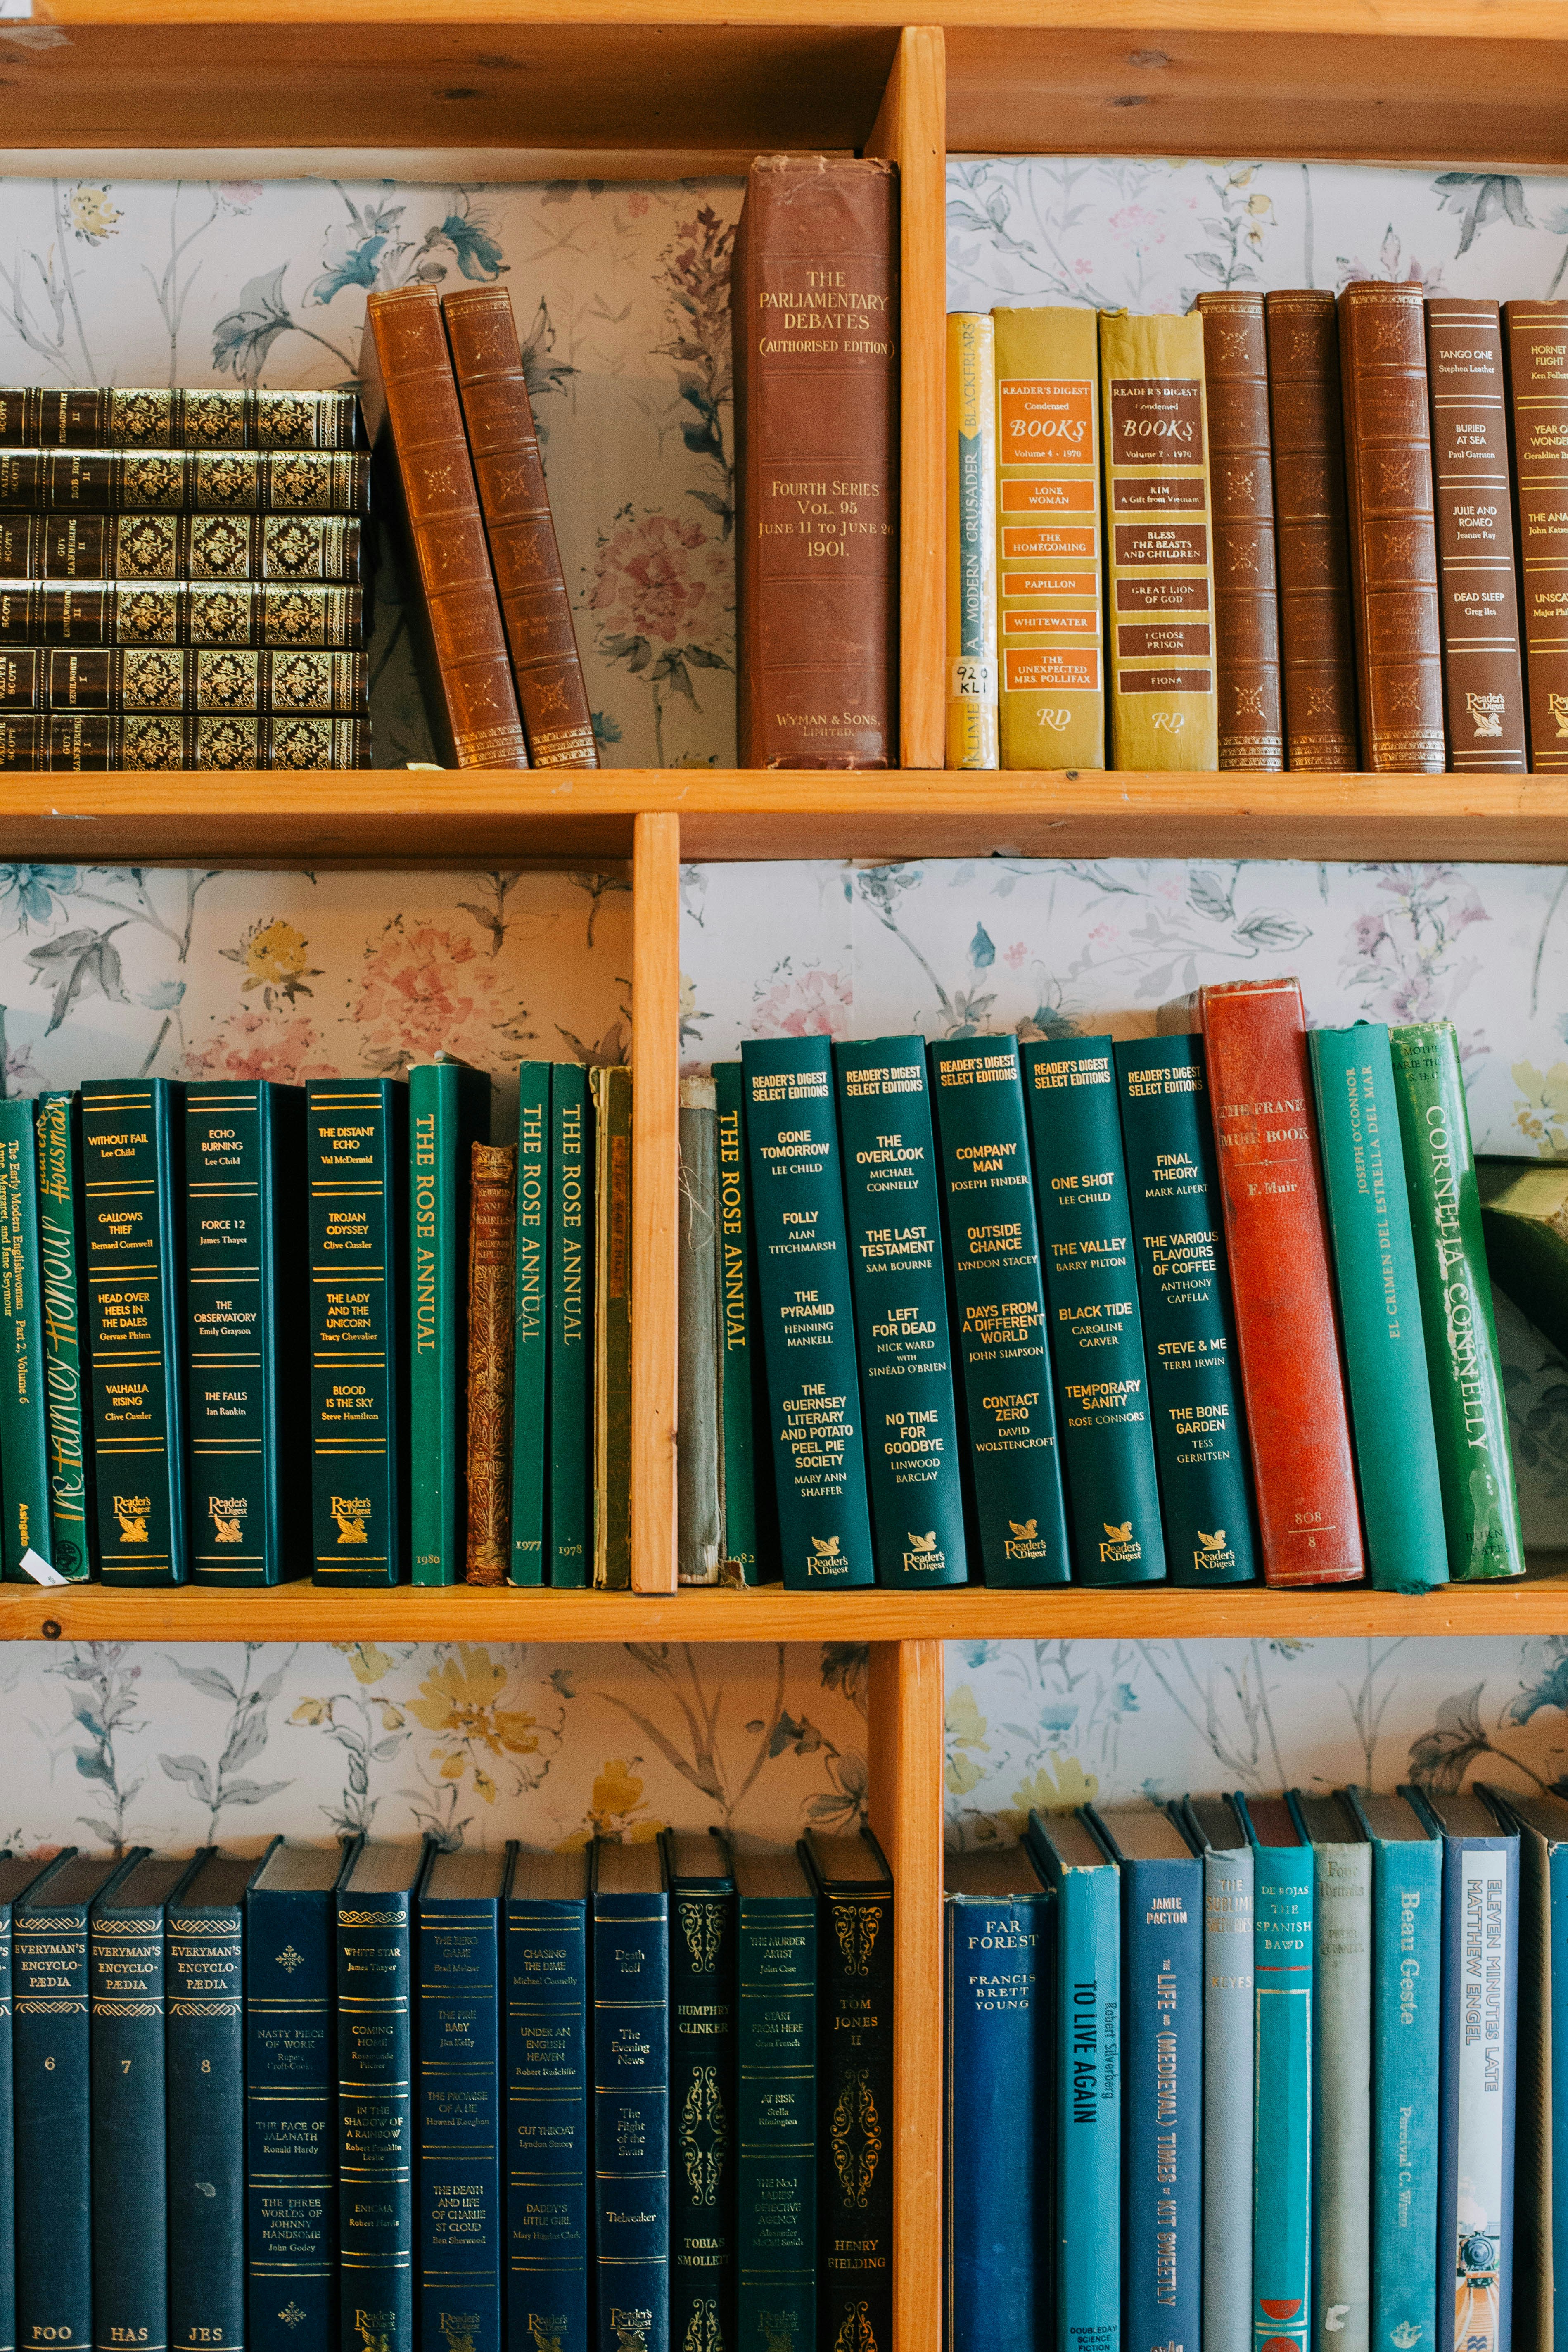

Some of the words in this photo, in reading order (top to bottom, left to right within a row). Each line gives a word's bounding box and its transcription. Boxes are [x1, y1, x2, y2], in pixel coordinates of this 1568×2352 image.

[807, 272, 845, 287] THE
[760, 292, 889, 311] PARLIAMENTARY
[785, 314, 869, 329] DEBATES
[760, 338, 839, 356] (AUTHORISED
[844, 340, 894, 359] EDITION)
[1440, 350, 1472, 358] TANGO
[1474, 351, 1492, 359] ONE
[964, 322, 975, 427] BLACKFRIARS
[1439, 365, 1468, 373] Stephen
[1011, 420, 1086, 442] BOOKS
[773, 481, 826, 496] FOURTH
[833, 481, 879, 496] SERIES
[966, 452, 979, 542] CRUSADER
[797, 501, 834, 514] VOL.
[840, 502, 857, 514] 95
[1453, 506, 1474, 515] JULIE
[759, 523, 793, 538] JUNE
[800, 522, 811, 533] 11
[818, 523, 836, 533] TO
[840, 522, 877, 536] JUNE
[1459, 518, 1493, 528] ROMEO
[68, 520, 76, 574] MANNERING
[808, 542, 849, 556] 1901.
[967, 555, 979, 622] MODERN
[1454, 593, 1479, 601] DEAD
[1482, 593, 1504, 601] SLEEP
[64, 590, 72, 638] KENILWORTH
[967, 637, 979, 650] A
[957, 666, 988, 680] 920
[777, 714, 826, 725] WYMAN
[831, 716, 840, 724] &
[844, 713, 880, 725] SONS.
[1037, 709, 1071, 731] RD
[752, 1074, 795, 1088] READER'S
[796, 1071, 827, 1085] DIGEST
[753, 1089, 786, 1102] SELECT
[788, 1085, 828, 1099] EDITIONS
[1346, 1068, 1362, 1142] O'CONNOR
[88, 1135, 126, 1145] WITHOUT
[130, 1134, 148, 1143] FAIL
[417, 1114, 434, 1165] THE
[778, 1130, 811, 1143] GONE
[114, 1148, 135, 1156] Child
[761, 1143, 829, 1158] TOMORROW
[957, 1143, 1017, 1159] COMPANY
[772, 1166, 787, 1175] LEE
[790, 1163, 822, 1173] CHILD
[973, 1159, 1003, 1172] MAN
[1354, 1146, 1370, 1194] JOSEPH
[1052, 1176, 1078, 1189] ONE
[1082, 1173, 1114, 1188] SHOT
[1249, 1184, 1261, 1195] F.
[1265, 1181, 1297, 1193] Muir
[417, 1175, 434, 1237] ROSE
[98, 1212, 143, 1222] GALLOWS
[329, 1213, 365, 1222] TROJAN
[783, 1211, 818, 1224] FOLLY
[109, 1225, 132, 1234] THIEF
[202, 1220, 230, 1229] FORCE
[235, 1220, 245, 1229] 12
[326, 1226, 369, 1235] ODYSSEY
[1426, 1104, 1464, 1269] CORNELIA
[1449, 1282, 1489, 1452] CONNELLY
[216, 1301, 232, 1309] THE
[418, 1247, 434, 1354] ANNUAL
[194, 1313, 256, 1322] OBSERVATORY
[781, 1304, 834, 1317] PYRAMID
[1059, 1305, 1101, 1321] BLACK
[1104, 1302, 1132, 1315] TIDE
[1158, 1341, 1195, 1355] STEVE
[1199, 1341, 1207, 1351] &
[1210, 1339, 1226, 1350] ME
[106, 1384, 149, 1393] VALHALLA
[1065, 1381, 1141, 1399] TEMPORARY
[113, 1397, 142, 1406] RISING
[783, 1396, 846, 1411] GUERNSEY
[1083, 1395, 1127, 1410] SANITY
[788, 1411, 844, 1425] LITERARY
[796, 1454, 843, 1468] SOCIETY
[114, 1495, 151, 1514] Reader's
[1296, 1512, 1321, 1522] 808
[19, 1504, 29, 1546] Ashgate
[417, 1555, 440, 1565] 1980
[1152, 1898, 1182, 1909] JAMIE
[1147, 1912, 1187, 1926] PACTON
[1487, 1880, 1502, 1948] ELEVEN
[986, 1921, 1021, 1933] FAR
[1256, 1920, 1313, 1932] SPANISH
[1400, 1891, 1420, 1953] Beau
[1466, 1879, 1483, 1978] MATTHEW
[969, 1934, 1039, 1949] FOREST
[1264, 1938, 1304, 1951] BAWD
[16, 1944, 85, 1954] EVERYMAN'S
[22, 1961, 82, 1970] ENCYCLO-
[30, 1977, 71, 1987] PÆDIA
[969, 1975, 1034, 1984] FRANCIS
[977, 1987, 1028, 1997] BRETT
[1074, 1981, 1096, 2005] TO
[1399, 1959, 1420, 2024] Geste
[1485, 1956, 1500, 2040] MINUTES
[840, 1999, 871, 2009] TOM
[976, 2000, 1028, 2010] YOUNG
[1466, 1984, 1482, 2046] ENGEL
[834, 2017, 878, 2029] JONES
[1074, 2014, 1096, 2053] LIVE
[612, 2042, 650, 2053] Evening
[45, 2057, 55, 2070] 6
[122, 2060, 131, 2073] 7
[201, 2060, 211, 2072] 8
[618, 2055, 644, 2064] News
[1485, 2047, 1499, 2092] LATE
[1074, 2061, 1096, 2123] AGAIN
[606, 2212, 656, 2222] Tiebreaker
[33, 2327, 71, 2339] FOO
[111, 2328, 147, 2341] HAS
[189, 2328, 222, 2341] JES
